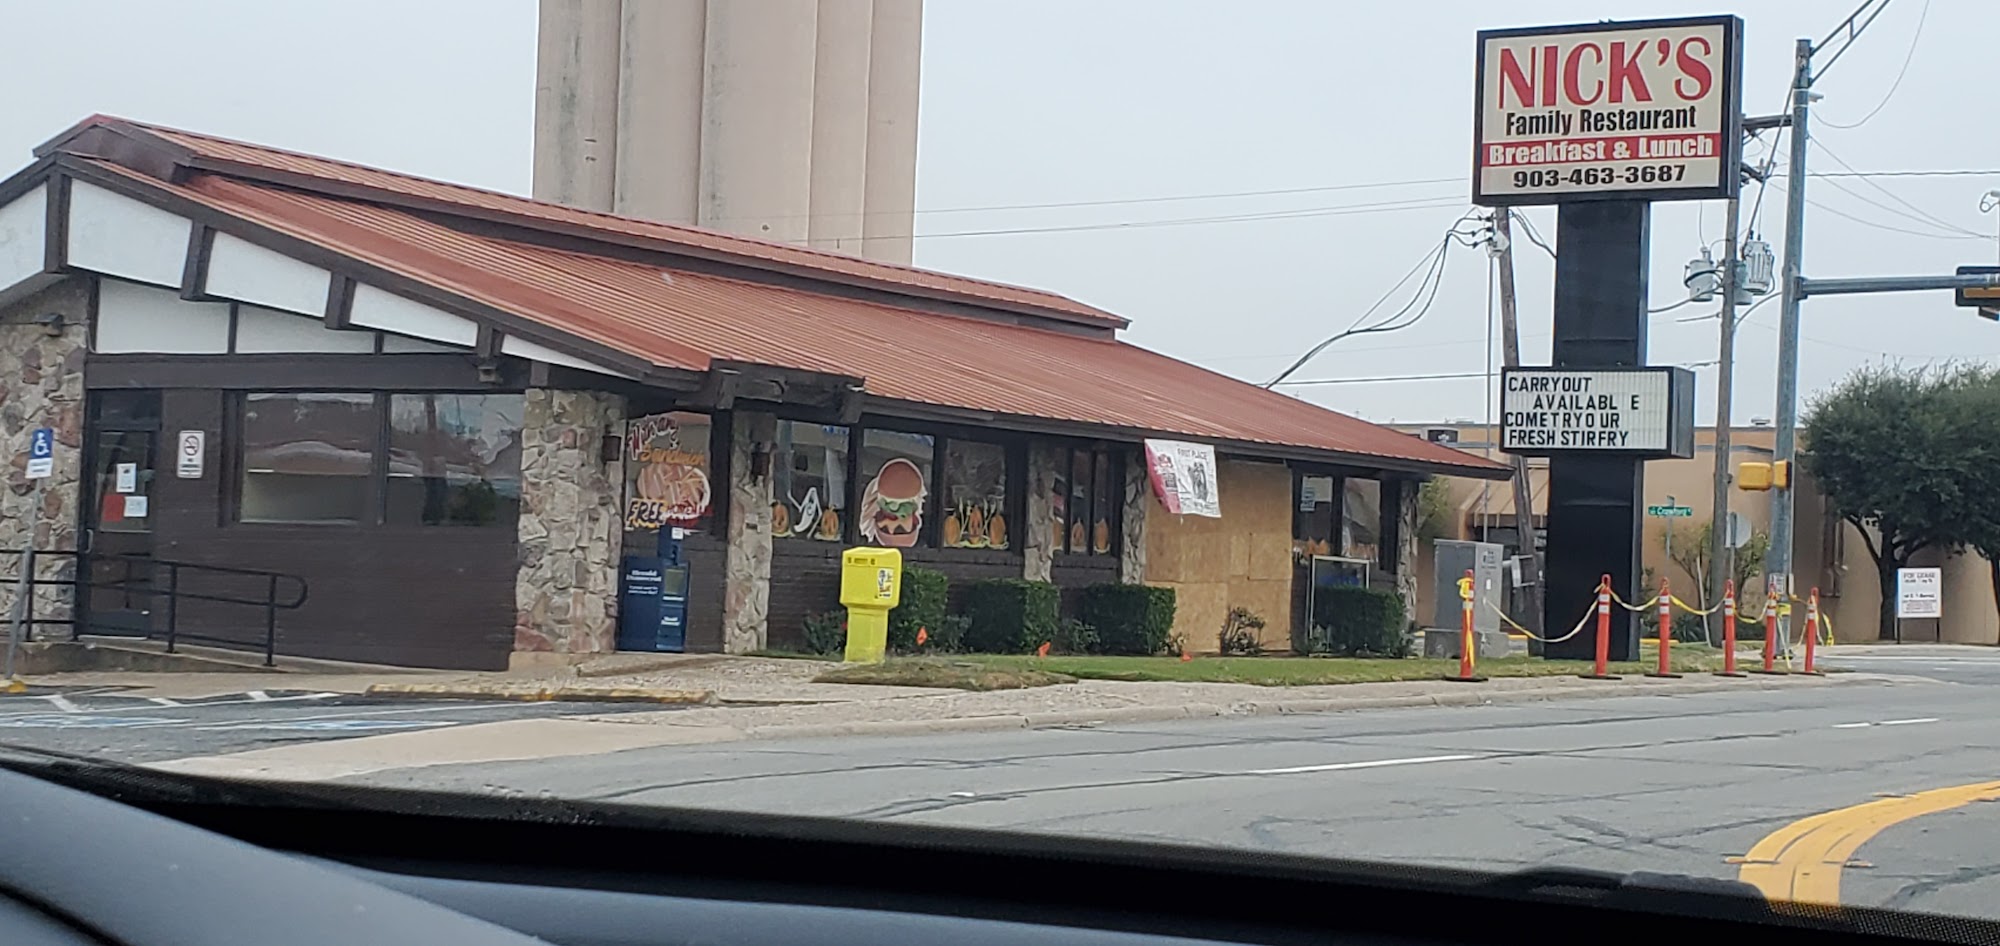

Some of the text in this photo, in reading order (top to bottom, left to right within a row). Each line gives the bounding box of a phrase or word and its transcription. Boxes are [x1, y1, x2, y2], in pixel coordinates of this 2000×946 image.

[1498, 36, 1713, 109] NICK'S
[1505, 105, 1696, 136] Family Restaurant
[1489, 135, 1713, 165] Breakfast & Lunch
[1513, 164, 1686, 188] 903-463-3687
[1509, 429, 1555, 446] FRESH
